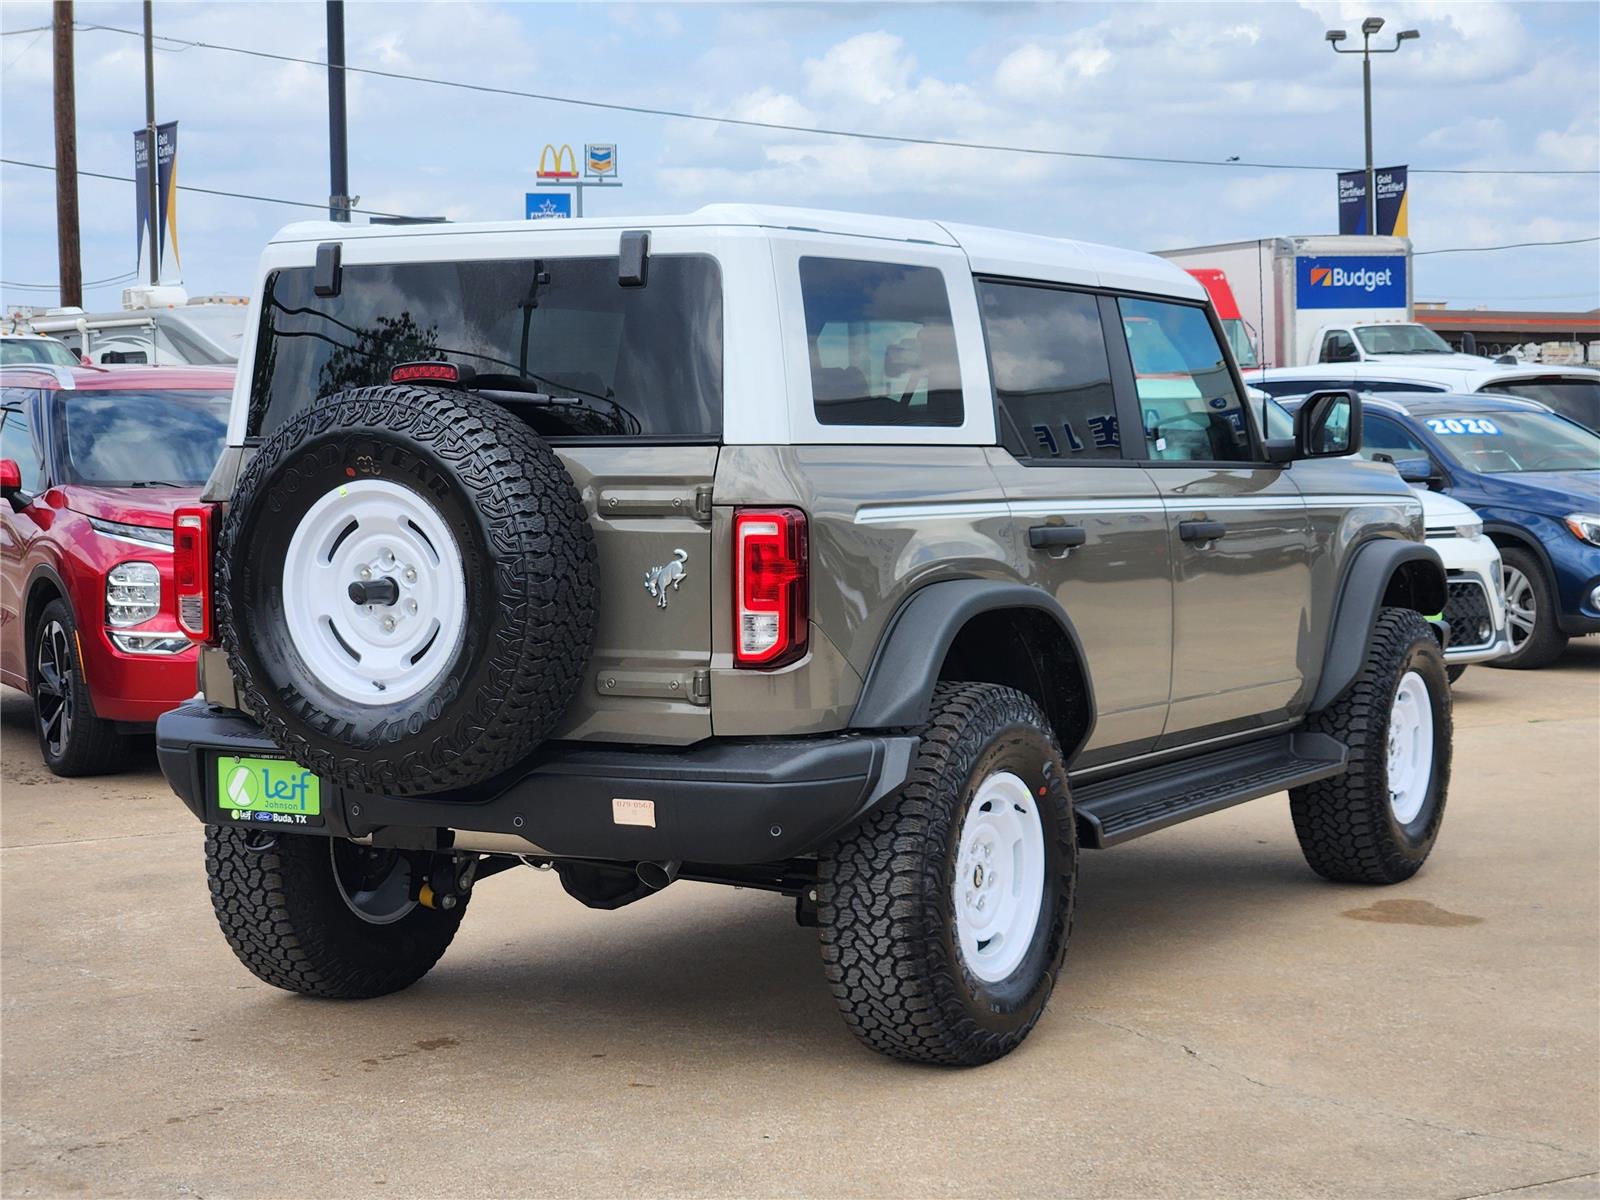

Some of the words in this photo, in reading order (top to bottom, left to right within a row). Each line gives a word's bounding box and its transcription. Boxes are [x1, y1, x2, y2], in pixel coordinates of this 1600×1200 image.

[1340, 180, 1354, 189] Blue
[1377, 174, 1392, 184] Gold
[1340, 186, 1366, 198] Certified
[1377, 182, 1404, 193] Certified
[1333, 268, 1392, 291] Budget
[1426, 419, 1498, 434] 2020
[262, 768, 312, 810] leif
[265, 800, 298, 810] Johnson
[273, 814, 294, 824] Buda,
[295, 815, 307, 824] TX
